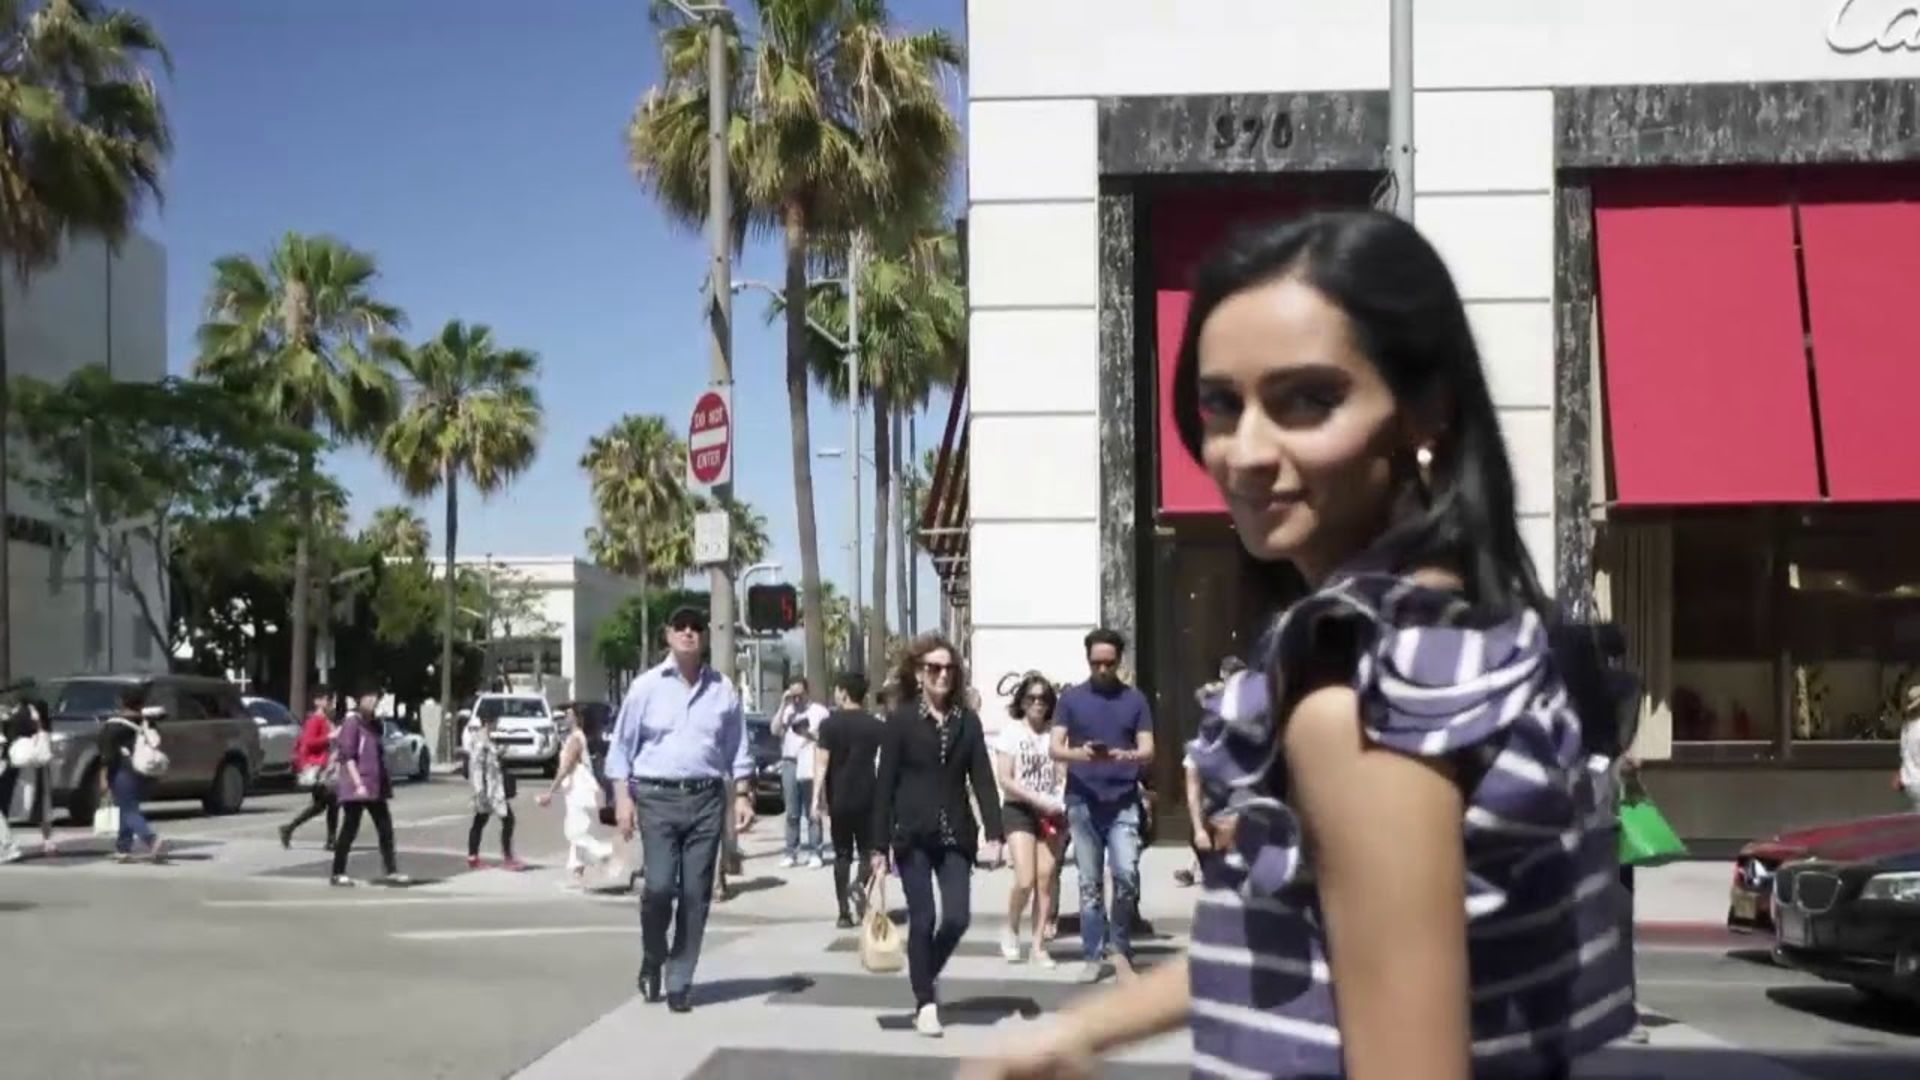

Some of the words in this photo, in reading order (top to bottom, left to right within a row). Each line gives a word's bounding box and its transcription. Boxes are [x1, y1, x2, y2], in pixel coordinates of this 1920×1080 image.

[694, 411, 706, 430] DO
[708, 407, 724, 425] NOT
[697, 450, 721, 470] ENTER
